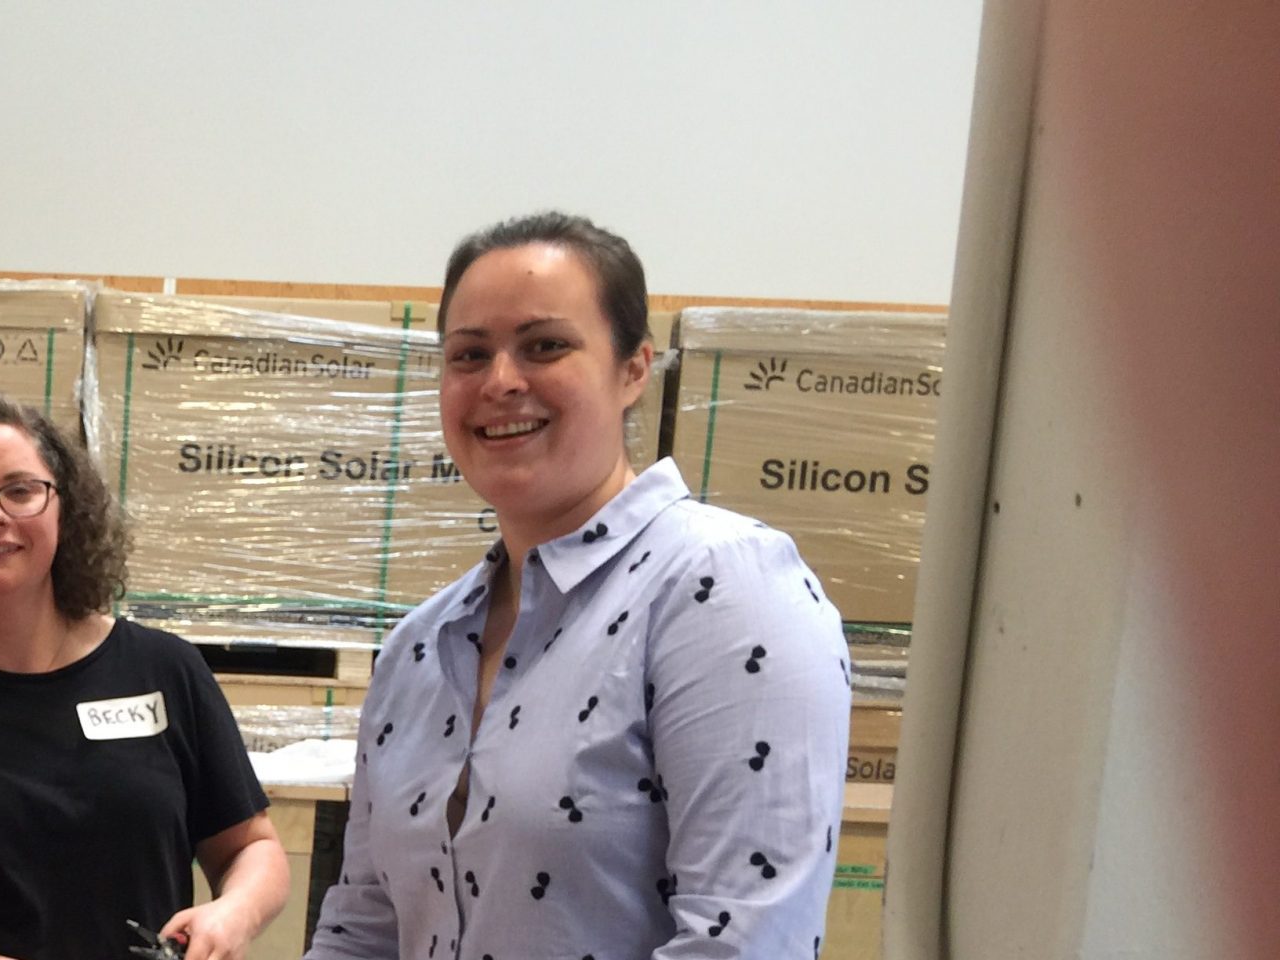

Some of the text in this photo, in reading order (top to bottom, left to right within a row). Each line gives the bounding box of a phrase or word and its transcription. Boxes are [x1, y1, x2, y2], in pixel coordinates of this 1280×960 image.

[194, 349, 375, 379] CanadianSolar
[179, 443, 306, 477] Silicon
[320, 450, 417, 481] Solar
[760, 459, 891, 493] Silicon
[88, 701, 158, 727] BECKY
